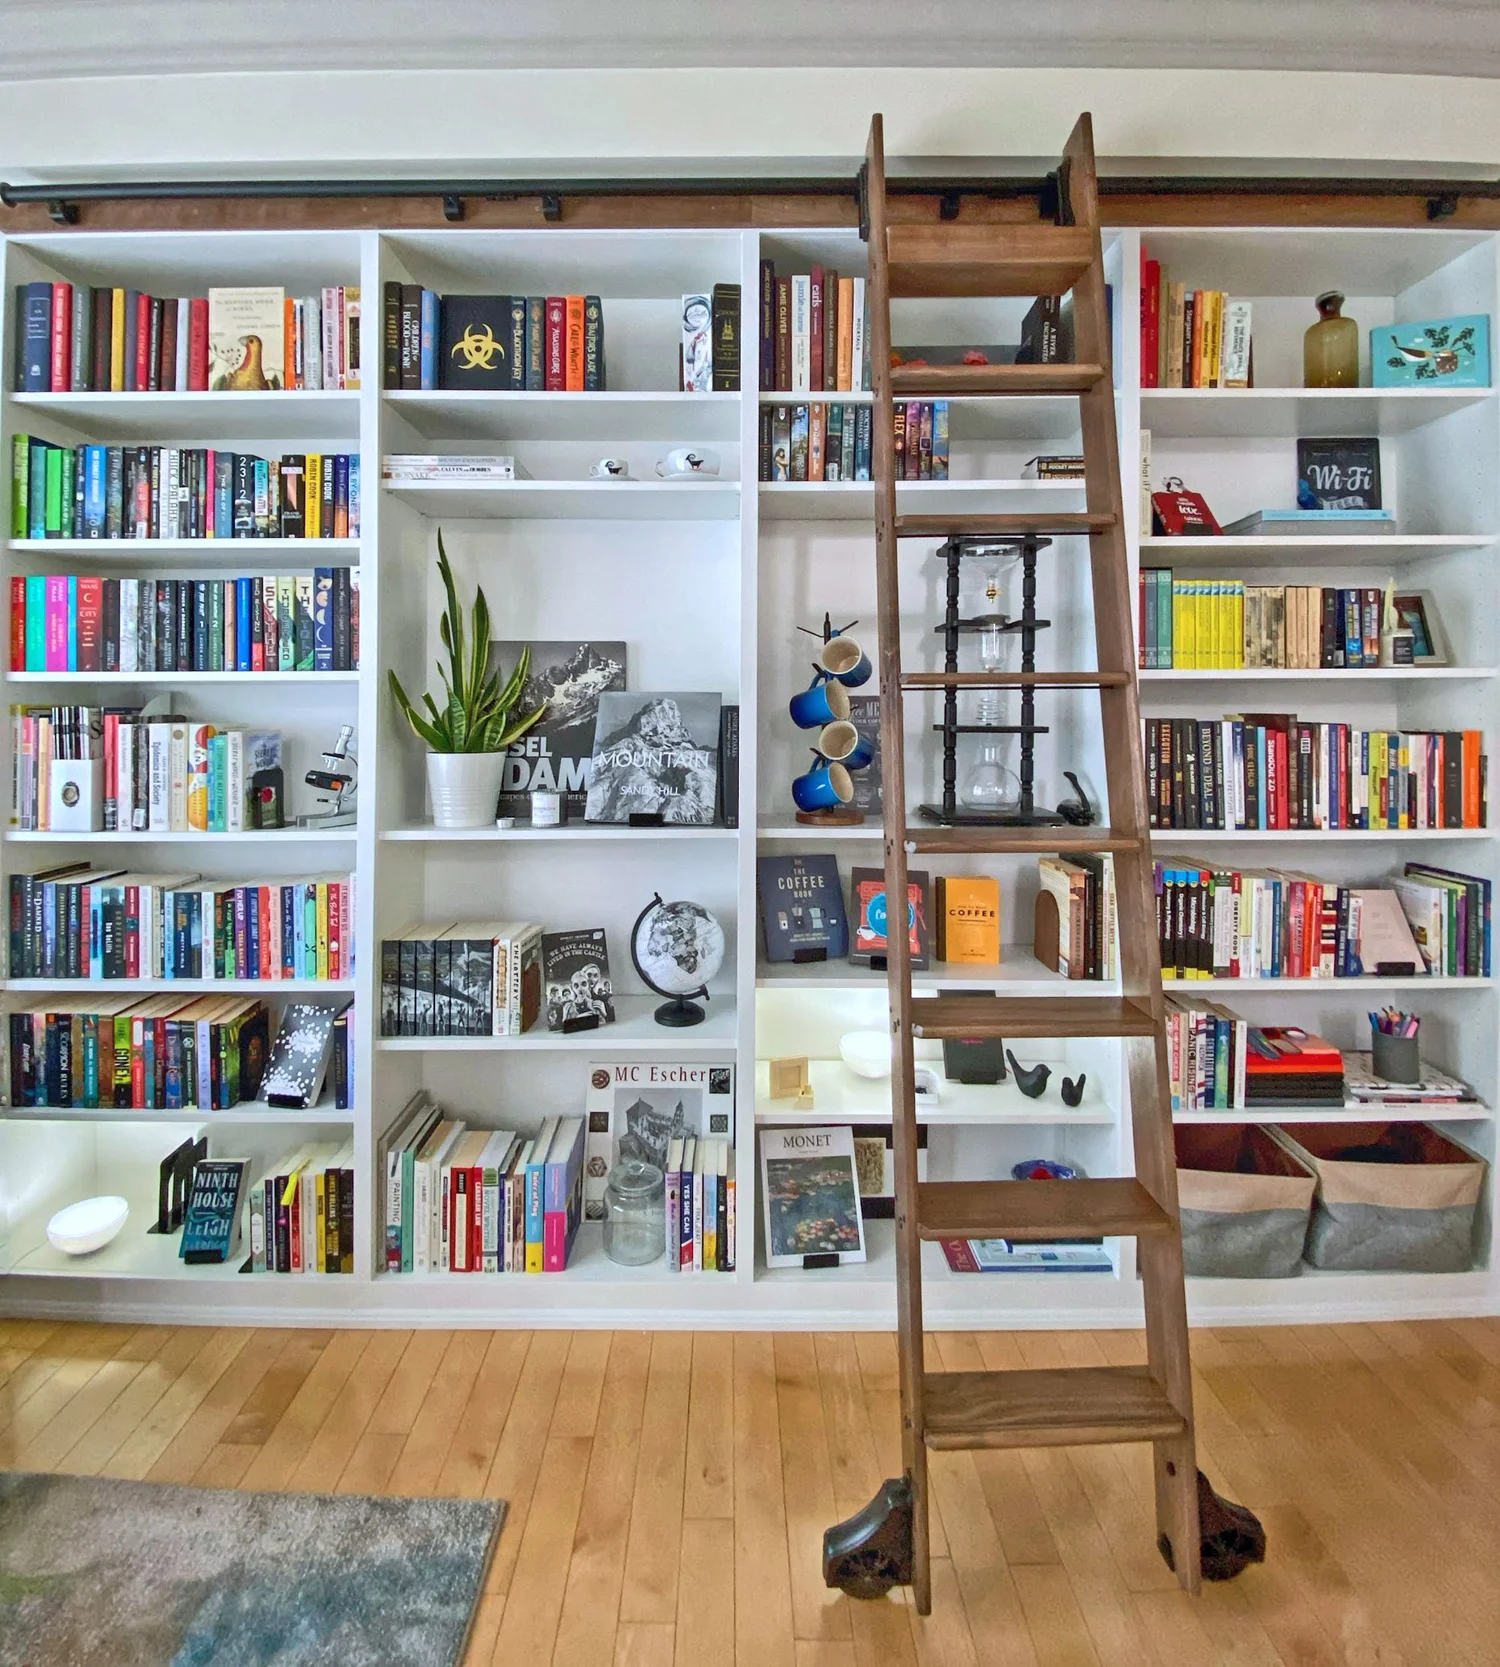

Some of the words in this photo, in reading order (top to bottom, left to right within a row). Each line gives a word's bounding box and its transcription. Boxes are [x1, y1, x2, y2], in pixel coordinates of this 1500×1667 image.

[779, 284, 787, 306] JAMIE
[811, 284, 822, 308] earls
[402, 311, 411, 338] BLOOD
[779, 306, 787, 333] OLIVER
[1185, 309, 1193, 345] Stargazer's
[411, 320, 420, 355] CHILDREN
[1042, 321, 1050, 362] ENCHANTED
[402, 347, 411, 369] BONE
[587, 353, 597, 374] BLADE
[894, 415, 905, 435] FLEX
[168, 449, 179, 480] CHUCK
[309, 459, 317, 481] ROBIN
[324, 459, 333, 481] ROBIN
[350, 479, 357, 488] BY
[1307, 464, 1373, 491] Wi-Fi
[309, 482, 317, 500] COOK
[324, 481, 333, 501] COOK
[221, 502, 226, 511] OF
[509, 736, 553, 757] SEL
[1161, 724, 1171, 764] EXECUTION
[1202, 728, 1212, 765] BEYOND
[152, 741, 161, 771] Epidemics
[600, 751, 711, 769] MOUNTAIN
[1267, 740, 1275, 777] StandOut
[153, 772, 161, 784] and
[502, 756, 593, 792] DAM
[152, 785, 161, 806] Society
[620, 786, 656, 797] SANDY
[658, 786, 681, 796] HILL
[1203, 775, 1213, 799] DEAL
[778, 876, 825, 890] COFFEE
[236, 889, 244, 900] FIX
[793, 890, 813, 898] BOOK
[33, 898, 43, 932] DAMNED
[236, 899, 244, 912] HER
[949, 909, 995, 918] COFFEE
[1189, 897, 1197, 934] Microbiology
[236, 912, 244, 921] UP
[342, 923, 348, 932] US
[105, 934, 113, 954] DeLillo
[549, 948, 560, 957] WE
[560, 943, 577, 952] HAVE
[578, 943, 604, 952] ALWAYS
[547, 954, 564, 967] LIVED
[583, 949, 606, 961] CASTLE
[59, 1031, 69, 1071] SCORPION
[1205, 1038, 1215, 1075] GENERATION
[615, 1066, 640, 1082] MC
[650, 1066, 707, 1083] Escher
[1188, 1059, 1196, 1093] RISING
[783, 1134, 832, 1149] MONET
[196, 1172, 239, 1188] NINTH
[532, 1171, 540, 1191] Rules
[193, 1191, 235, 1208] HOUSE
[392, 1182, 401, 1223] PAINTING
[530, 1200, 539, 1217] Play
[187, 1219, 229, 1236] LEIGH
